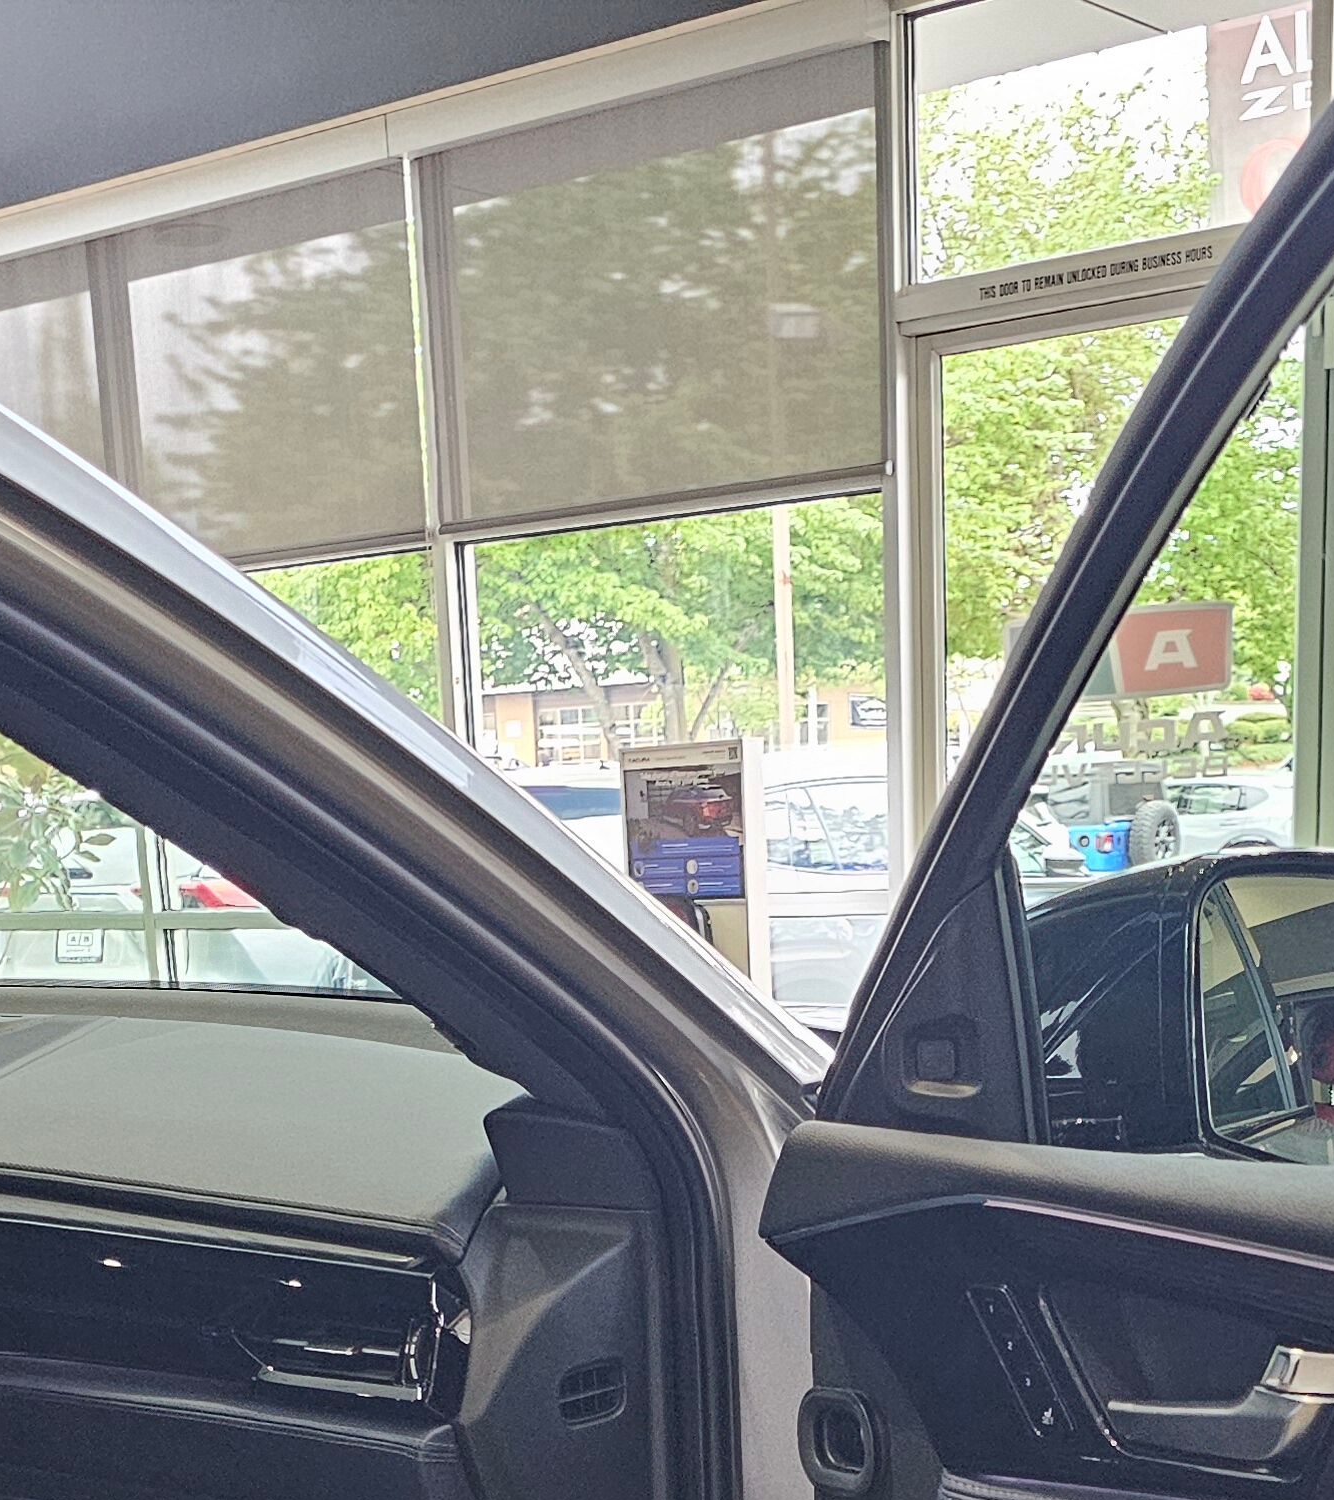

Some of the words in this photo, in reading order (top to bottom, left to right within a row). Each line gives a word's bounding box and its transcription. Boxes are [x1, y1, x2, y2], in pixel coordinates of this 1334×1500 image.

[979, 287, 996, 300] THIS
[999, 281, 1018, 298] DOOR
[1022, 280, 1031, 292] TO
[1034, 272, 1064, 290] REMAIN
[1067, 265, 1107, 284] UNLOCKED
[1110, 259, 1139, 277] DURING
[1142, 251, 1182, 270] BUSINESS
[1185, 246, 1213, 263] HOURS
